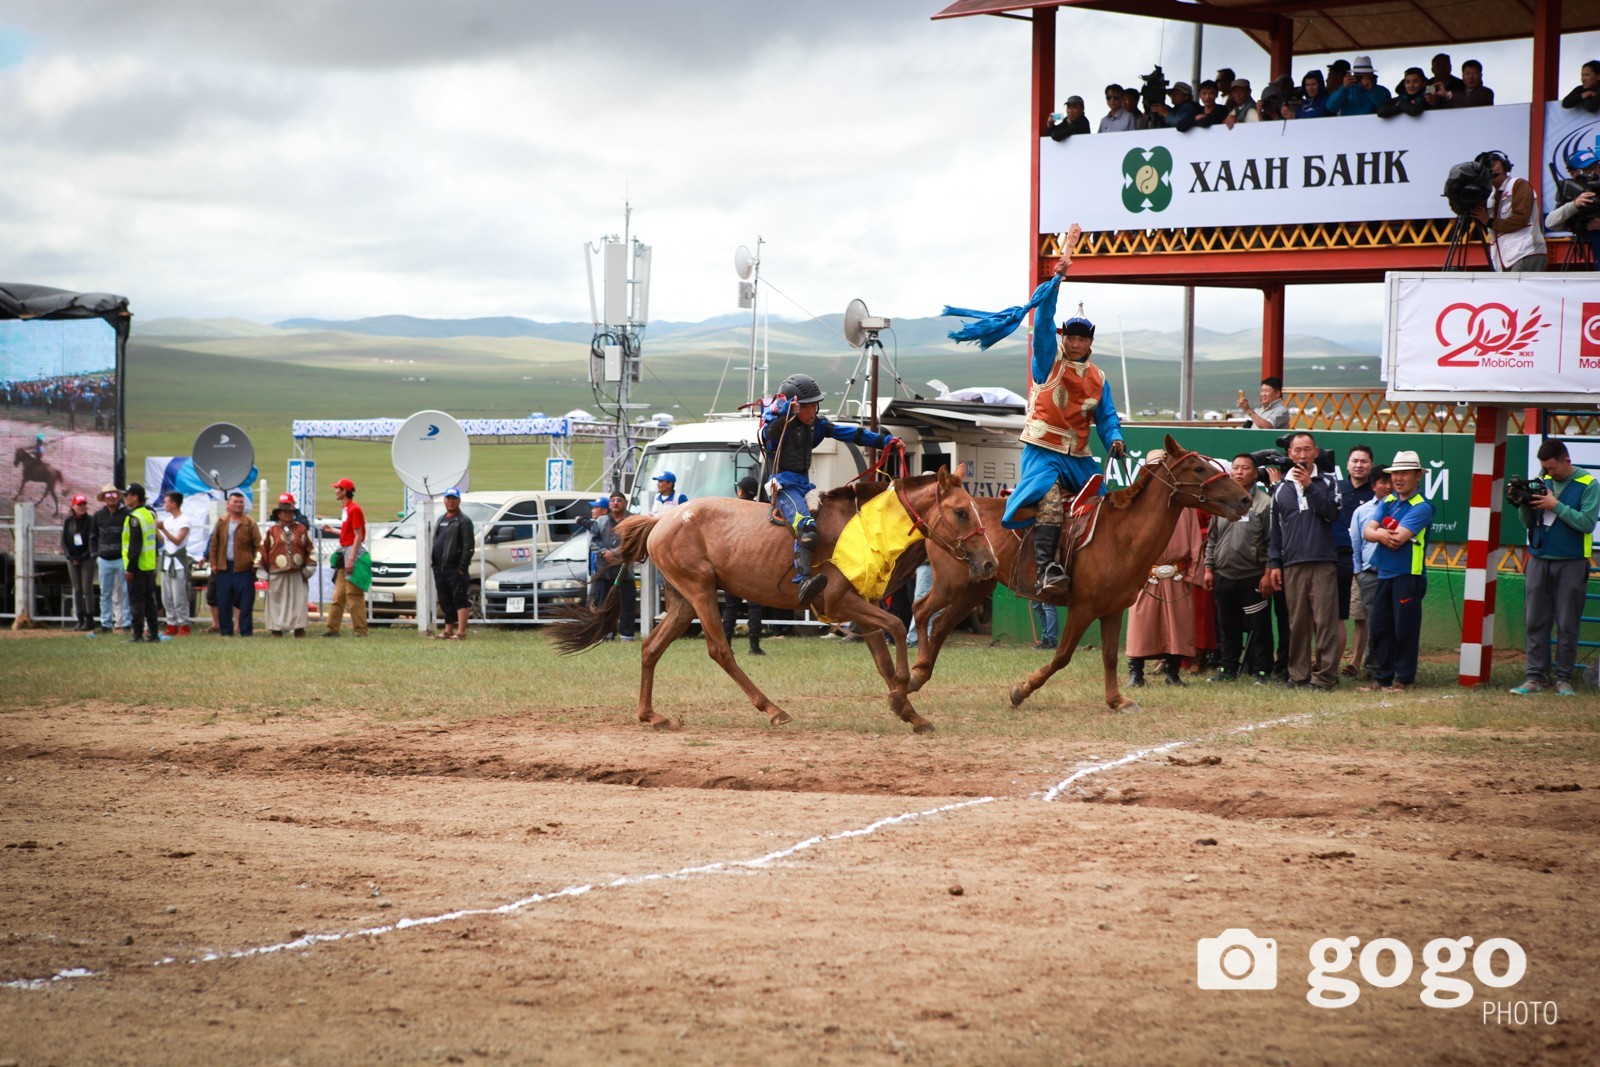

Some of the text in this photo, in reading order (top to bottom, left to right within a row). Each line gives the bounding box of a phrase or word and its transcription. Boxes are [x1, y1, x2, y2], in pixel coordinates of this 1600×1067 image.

[1188, 149, 1411, 193] ХААН БАНК
[1481, 357, 1534, 368] MobiCom
